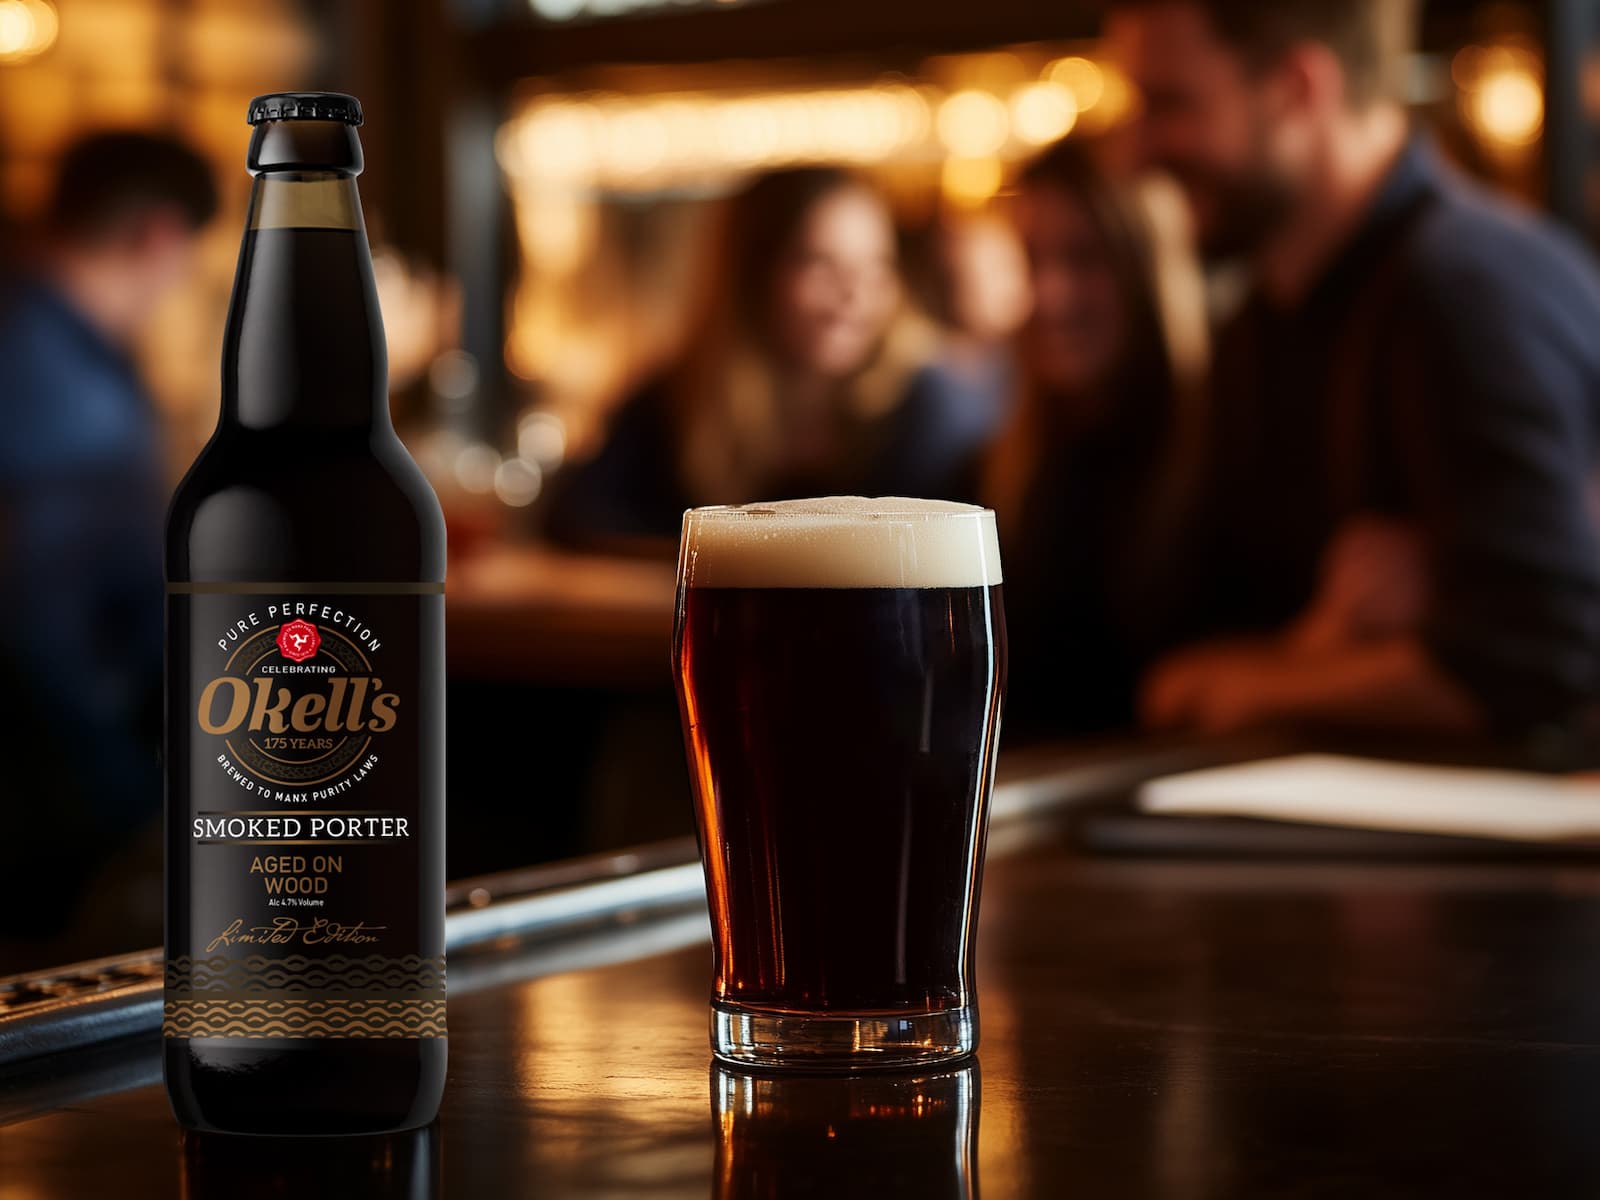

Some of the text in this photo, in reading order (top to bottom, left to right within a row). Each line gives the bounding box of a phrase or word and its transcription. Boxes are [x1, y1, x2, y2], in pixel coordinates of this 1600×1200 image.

[218, 613, 260, 651] PURE
[268, 603, 381, 652] PERFECTION
[261, 665, 336, 674] CELEBRATING
[197, 676, 400, 735] Okell's
[263, 738, 333, 750] 175 YEARS
[216, 753, 379, 803] BREWED TO MANX PURITY LAWS
[192, 817, 410, 838] SMOKED PORTER
[250, 856, 343, 873] AGED ON
[264, 877, 328, 894] WOOD
[268, 898, 324, 907] Alc 4.7% Volume
[205, 916, 387, 953] Limited Edition
